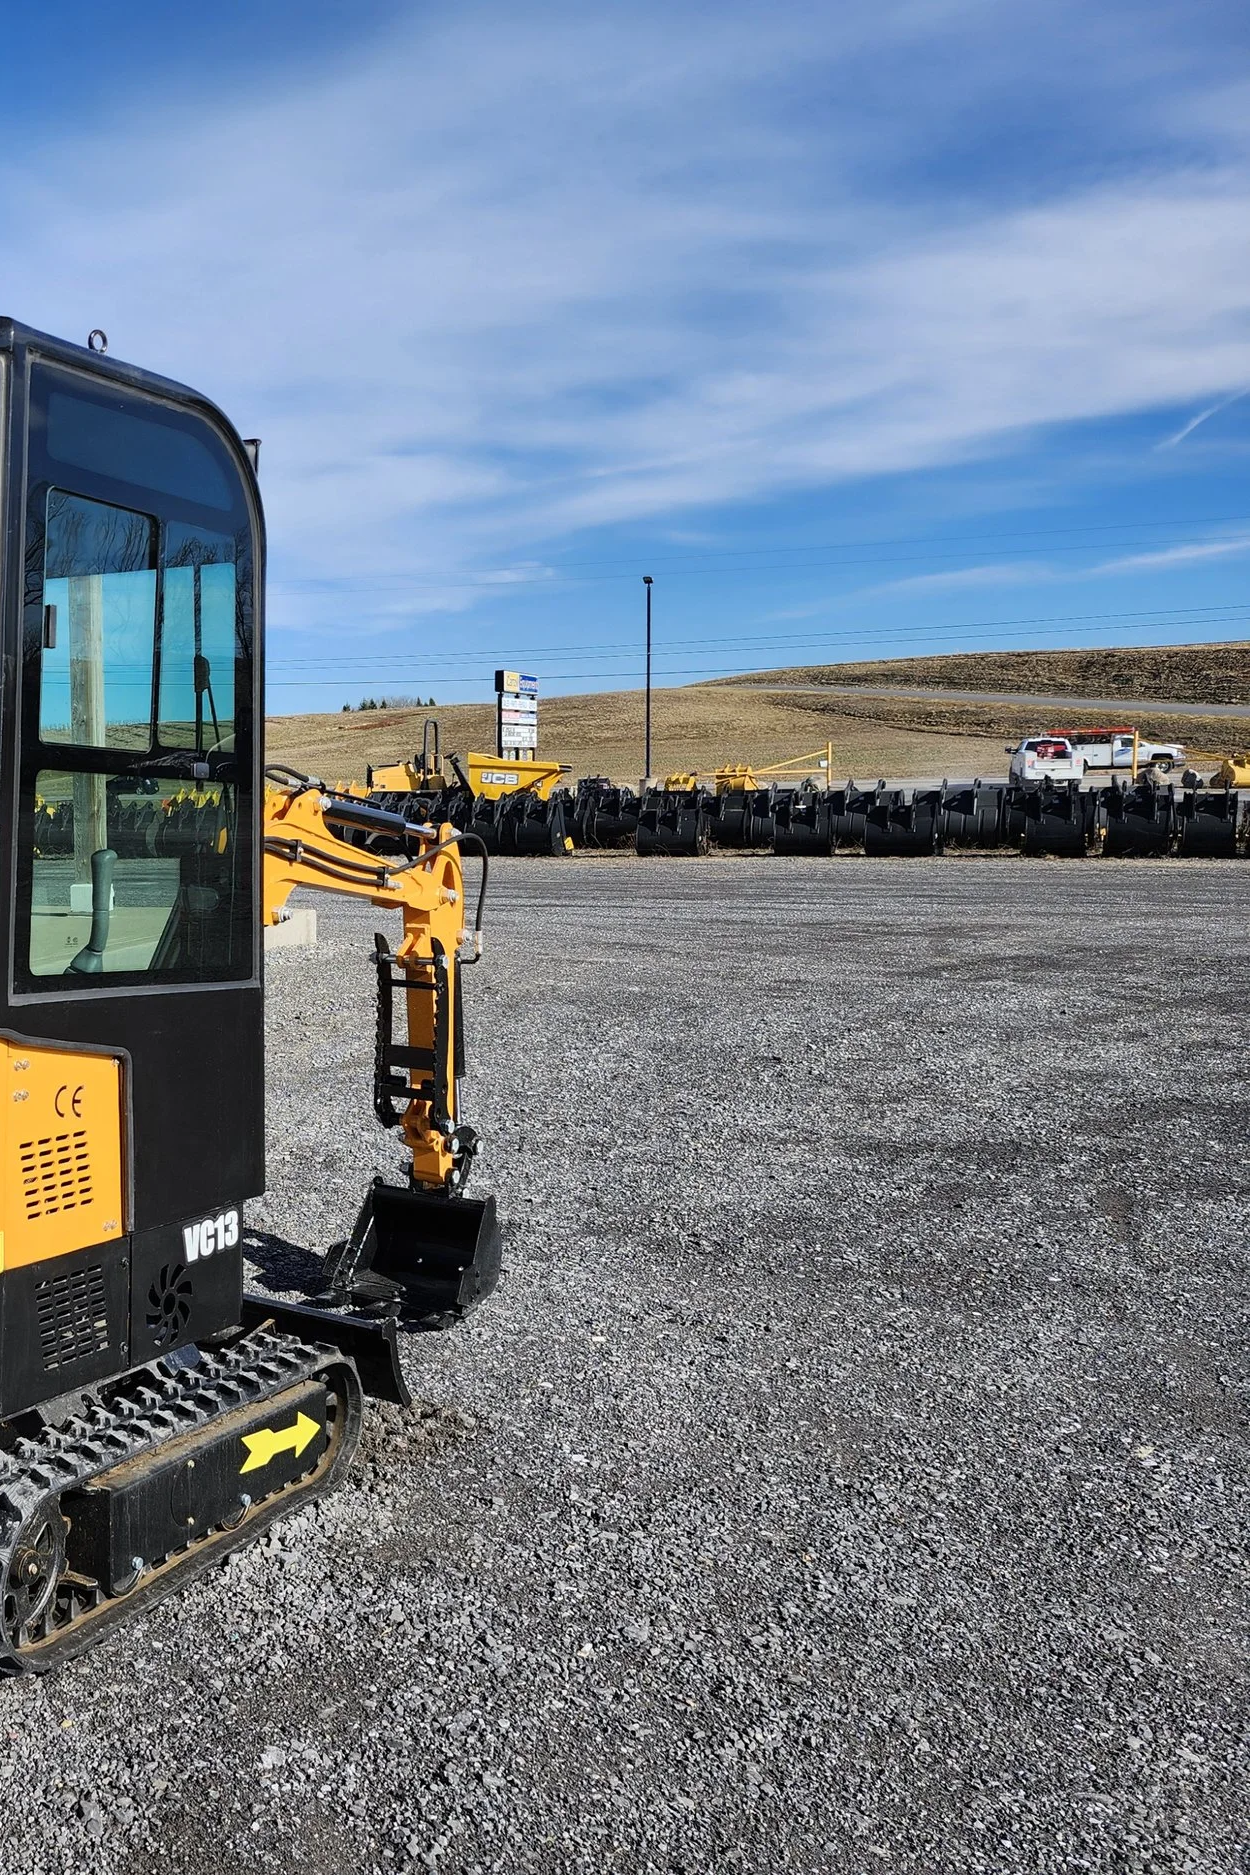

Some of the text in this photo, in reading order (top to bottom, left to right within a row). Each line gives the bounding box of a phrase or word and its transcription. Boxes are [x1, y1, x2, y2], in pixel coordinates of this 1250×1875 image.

[481, 772, 518, 785] JCB
[54, 1085, 84, 1118] CE
[183, 1210, 239, 1263] VC13
